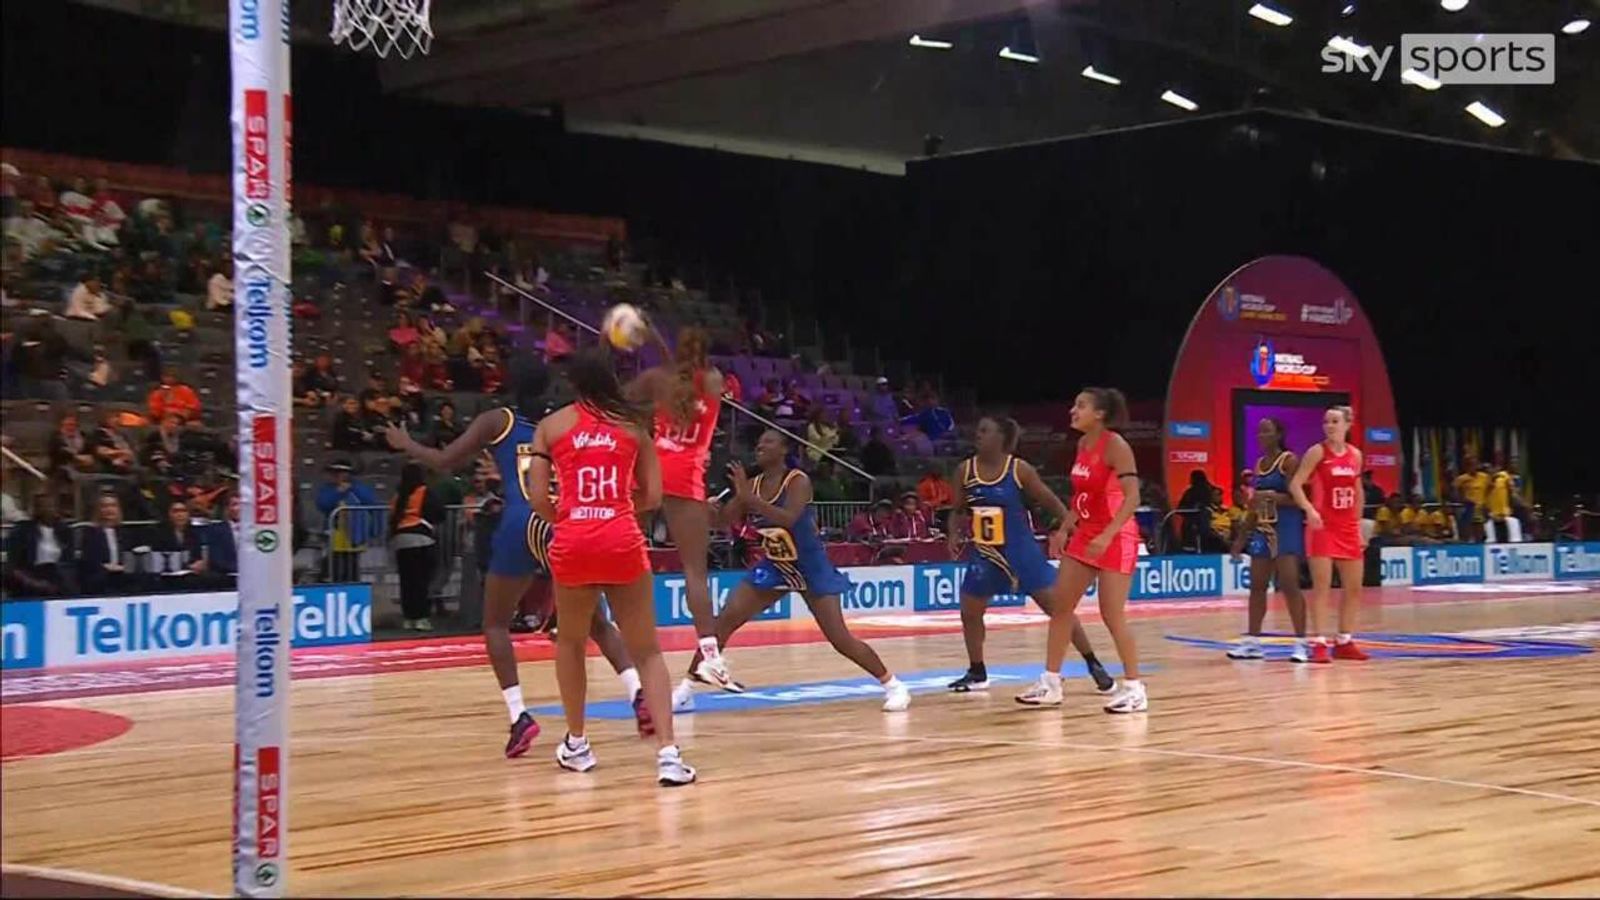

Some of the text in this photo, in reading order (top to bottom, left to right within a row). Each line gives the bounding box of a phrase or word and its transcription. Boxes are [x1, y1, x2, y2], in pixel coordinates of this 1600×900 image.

[247, 115, 269, 199] SPAR
[247, 278, 273, 368] Telkom
[253, 442, 277, 523] SPAR
[1136, 560, 1216, 594] Telkom
[1416, 549, 1481, 578] Telkom
[66, 602, 241, 655] Telkom
[254, 603, 280, 697] Telkom
[258, 773, 278, 857] SPAR
